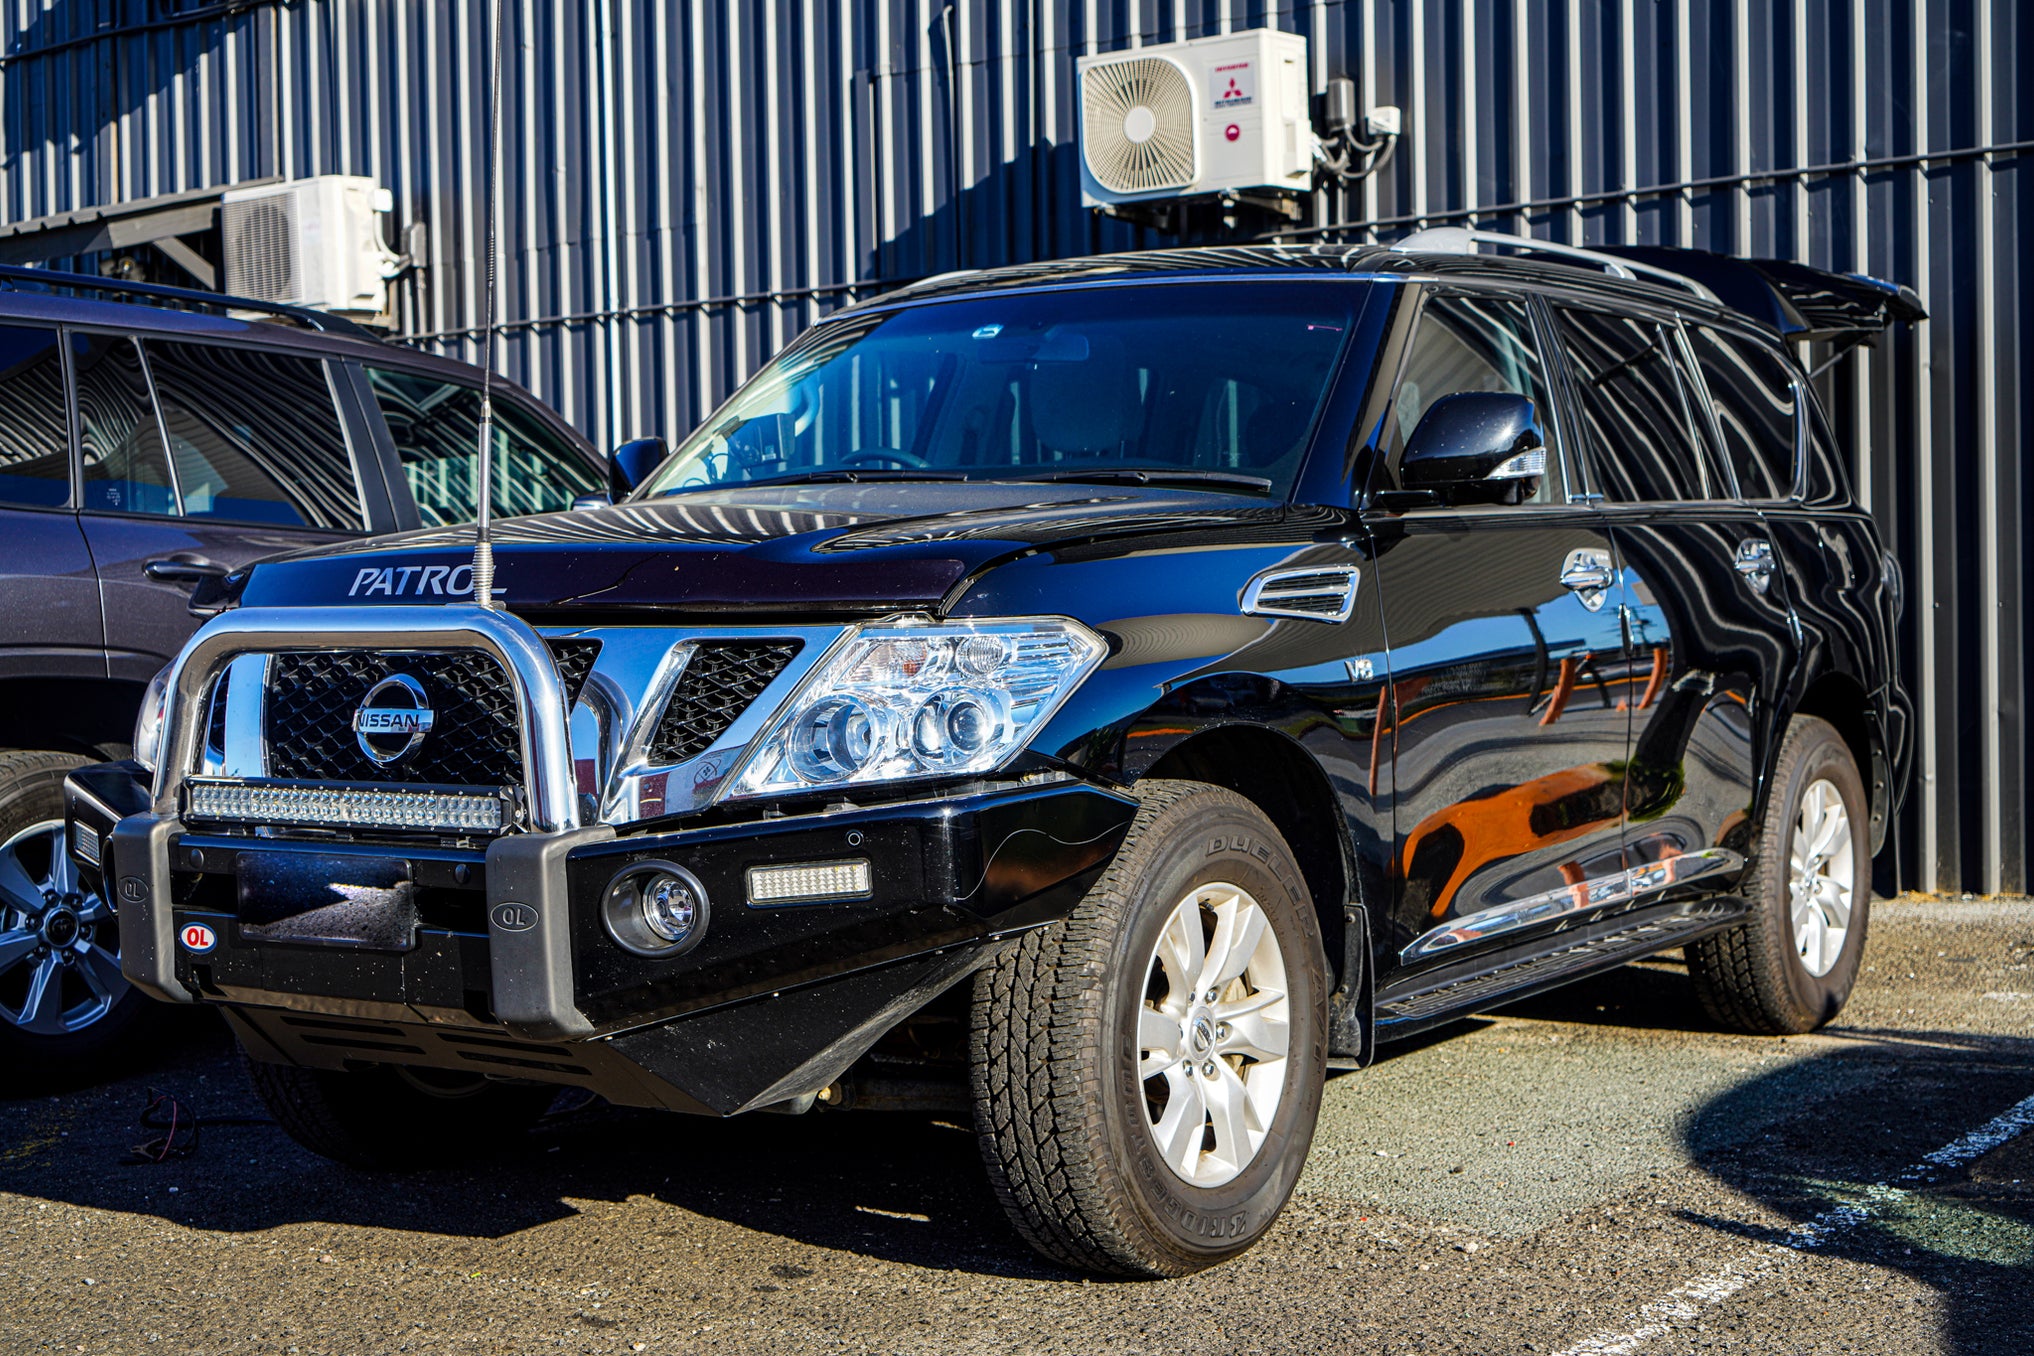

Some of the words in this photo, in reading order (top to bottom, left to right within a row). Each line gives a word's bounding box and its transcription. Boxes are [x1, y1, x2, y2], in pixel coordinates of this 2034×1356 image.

[1344, 659, 1373, 682] V8
[357, 713, 419, 728] NISSAN
[125, 882, 140, 898] OL
[1206, 835, 1315, 939] DUELER
[503, 907, 526, 926] OL
[187, 928, 209, 947] OL
